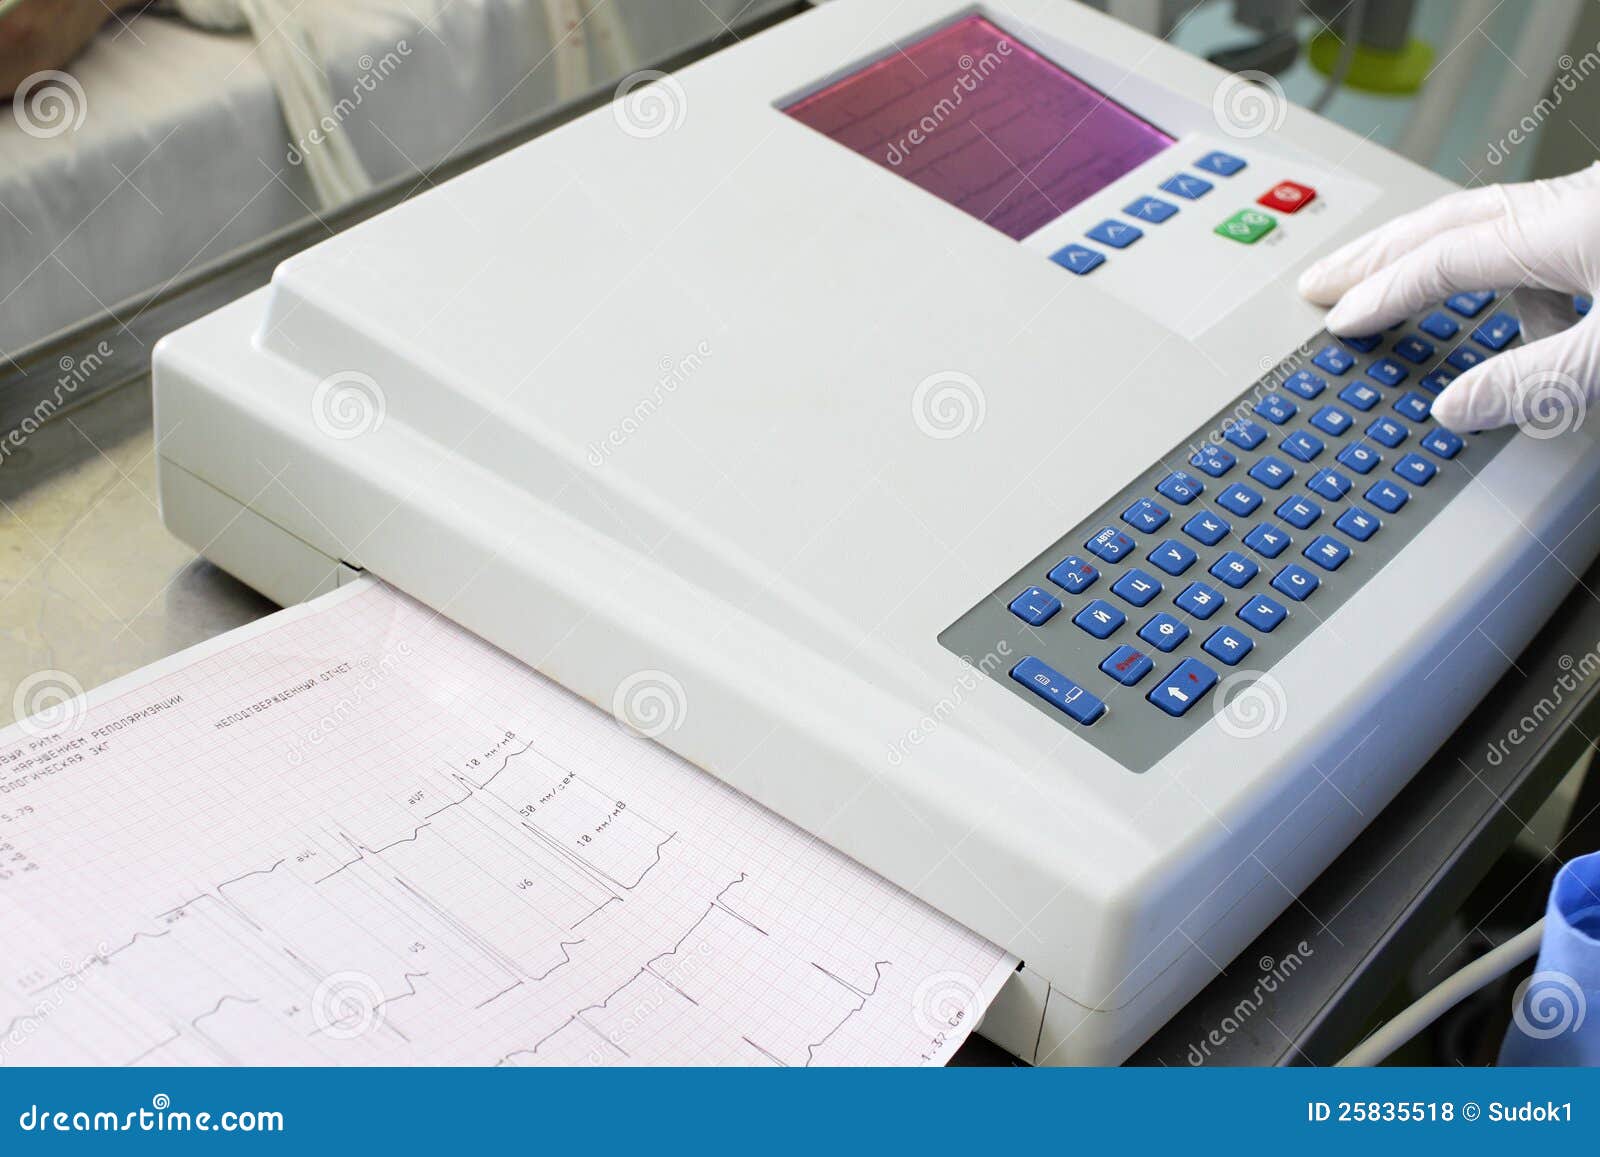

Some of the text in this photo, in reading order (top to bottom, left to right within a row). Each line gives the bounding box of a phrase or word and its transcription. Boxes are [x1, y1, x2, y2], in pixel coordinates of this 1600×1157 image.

[1270, 406, 1284, 417] 8
[1240, 430, 1252, 442] 7
[1298, 438, 1311, 449] Г
[1354, 449, 1369, 460] О
[1208, 458, 1222, 469] 6
[1267, 464, 1282, 476] Н
[1326, 476, 1341, 487] Р
[1174, 485, 1189, 496] 5
[1382, 487, 1397, 498] Т
[1234, 491, 1250, 504] Е
[1293, 503, 1309, 516] П
[1143, 513, 1156, 523] 4
[1353, 515, 1369, 528] И
[1202, 519, 1219, 532] К
[1096, 529, 1115, 545] АВТО
[1263, 533, 1278, 545] А
[1104, 542, 1119, 553] 3
[1321, 543, 1339, 557] М
[1167, 548, 1182, 561] У
[1229, 561, 1245, 573] В
[1067, 572, 1083, 584] 2
[1291, 574, 1306, 585] С
[1131, 579, 1151, 592] Ц
[1193, 590, 1212, 605] Ы
[1029, 605, 1042, 616] 1
[1257, 604, 1273, 615] Ч
[1092, 609, 1112, 624] Й
[1159, 623, 1174, 635] Ф
[1223, 636, 1239, 649] Я
[91, 694, 184, 738] РЕПОЛЯРИЗАЦИИ
[465, 757, 481, 771] 10
[519, 803, 537, 818] 50
[575, 834, 593, 848] 10
[517, 877, 534, 891] V6
